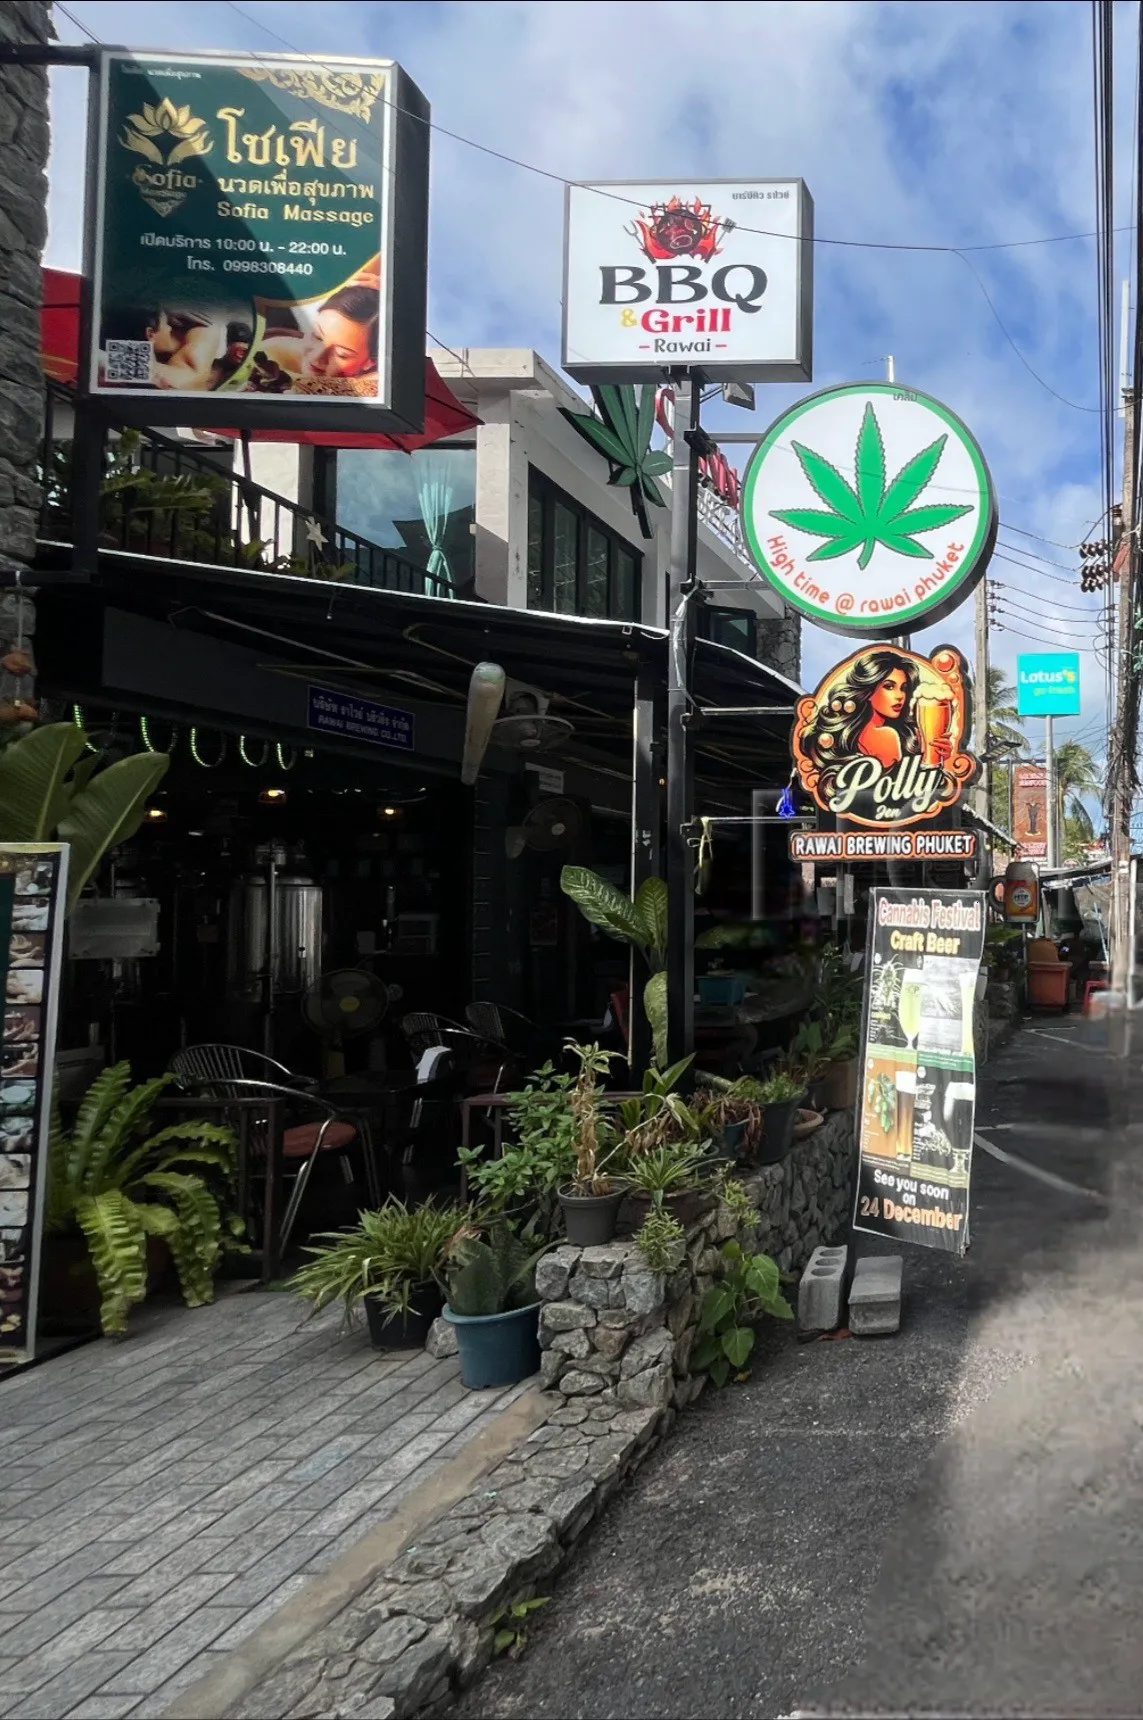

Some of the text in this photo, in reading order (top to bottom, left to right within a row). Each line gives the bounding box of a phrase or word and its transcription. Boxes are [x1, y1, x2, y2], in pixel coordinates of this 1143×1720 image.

[217, 107, 358, 169] โซเฟีย
[218, 169, 375, 206] นวดเพื่อสุขภาพ
[218, 204, 374, 227] Sofia Massage
[140, 233, 211, 249] เปิดบริการ
[215, 238, 256, 252] 10:00
[289, 242, 329, 256] 22:00
[223, 260, 313, 276] 0998308440
[599, 264, 768, 314] BBQ
[641, 307, 732, 333] Grill
[654, 338, 711, 353] Rawai
[767, 535, 965, 615] High time @ rawai phuket
[318, 714, 344, 728] RAWAI
[829, 754, 943, 813] Polly
[795, 835, 973, 855] RAWAI BREWING PHUKET
[878, 897, 981, 931] Cannabis Festival
[890, 930, 961, 954] Craft Beer
[874, 1169, 894, 1187] See
[895, 1177, 917, 1193] you
[920, 1183, 949, 1200] soon
[902, 1193, 916, 1206] on
[860, 1196, 963, 1231] 24 December
